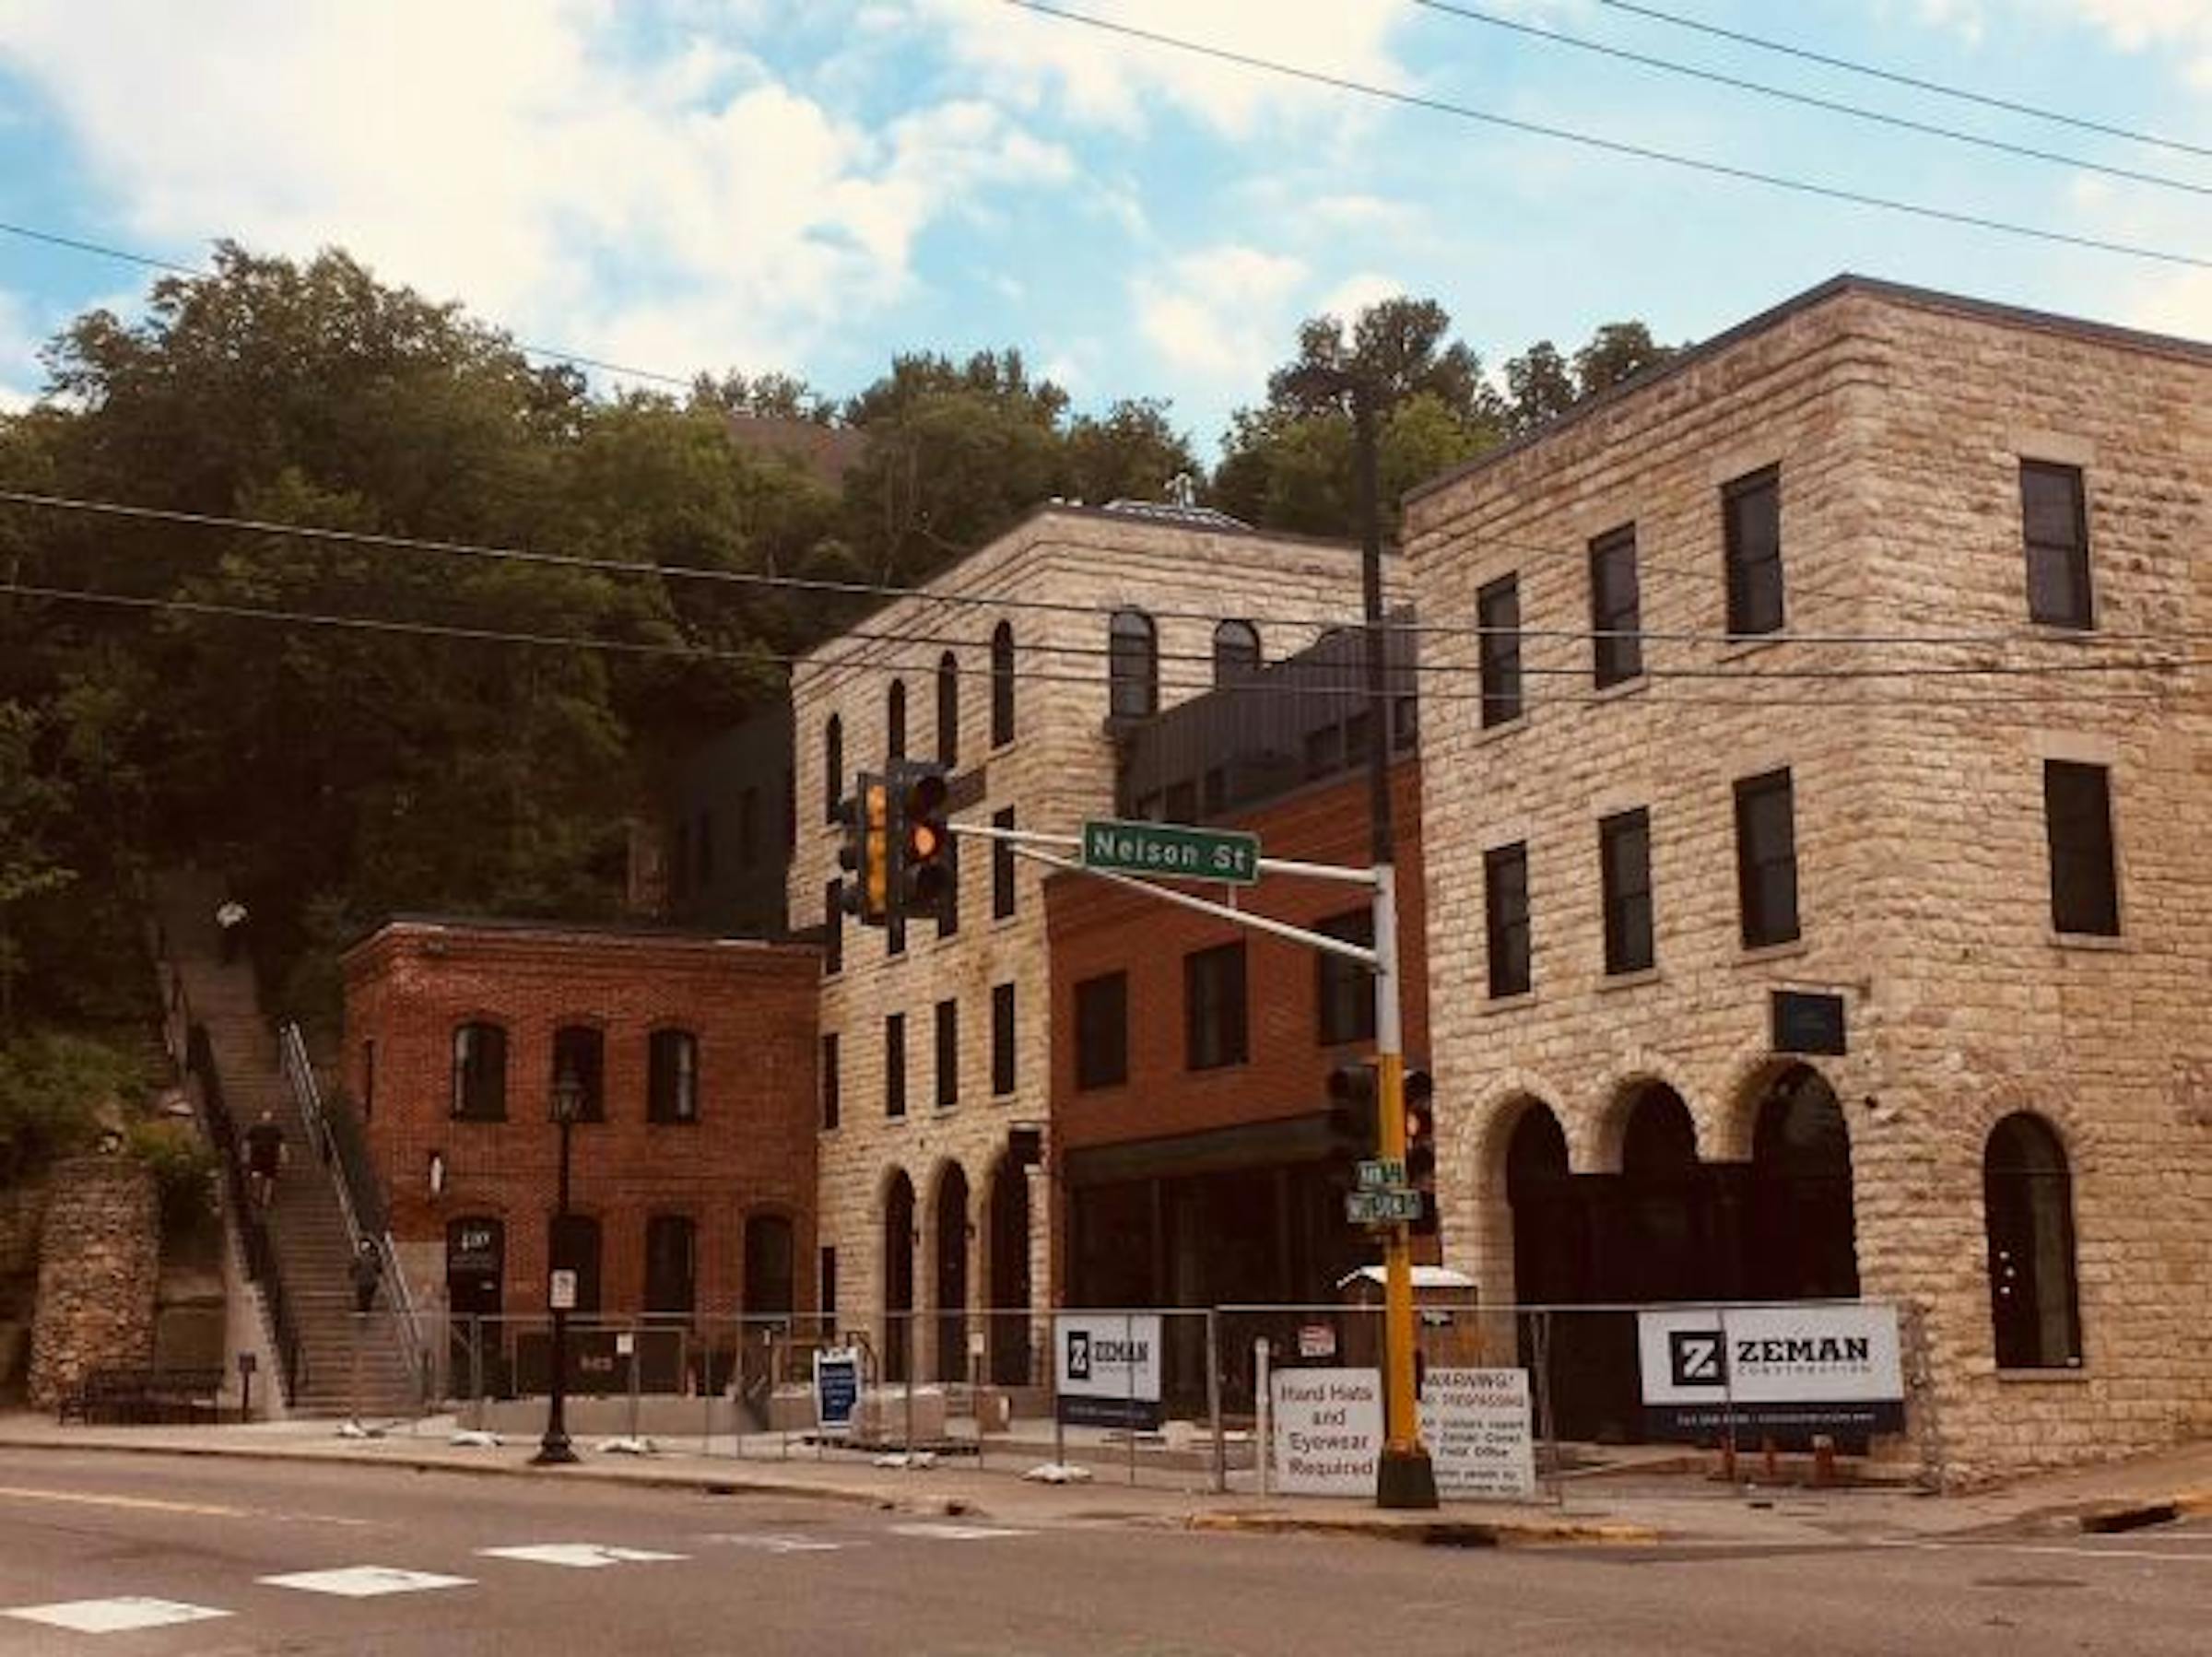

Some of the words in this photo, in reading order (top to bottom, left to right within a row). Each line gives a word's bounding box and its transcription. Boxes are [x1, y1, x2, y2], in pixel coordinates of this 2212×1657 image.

[1093, 830, 1198, 865] Nelson
[1212, 843, 1245, 872] St
[1681, 1339, 1719, 1379] Z
[1737, 1338, 1869, 1362] ZEMAN
[1281, 1384, 1324, 1402] Hard
[1330, 1384, 1372, 1402] Hats
[1312, 1408, 1346, 1427] and
[1288, 1431, 1369, 1454] Eyewear
[1289, 1458, 1373, 1477] Required
